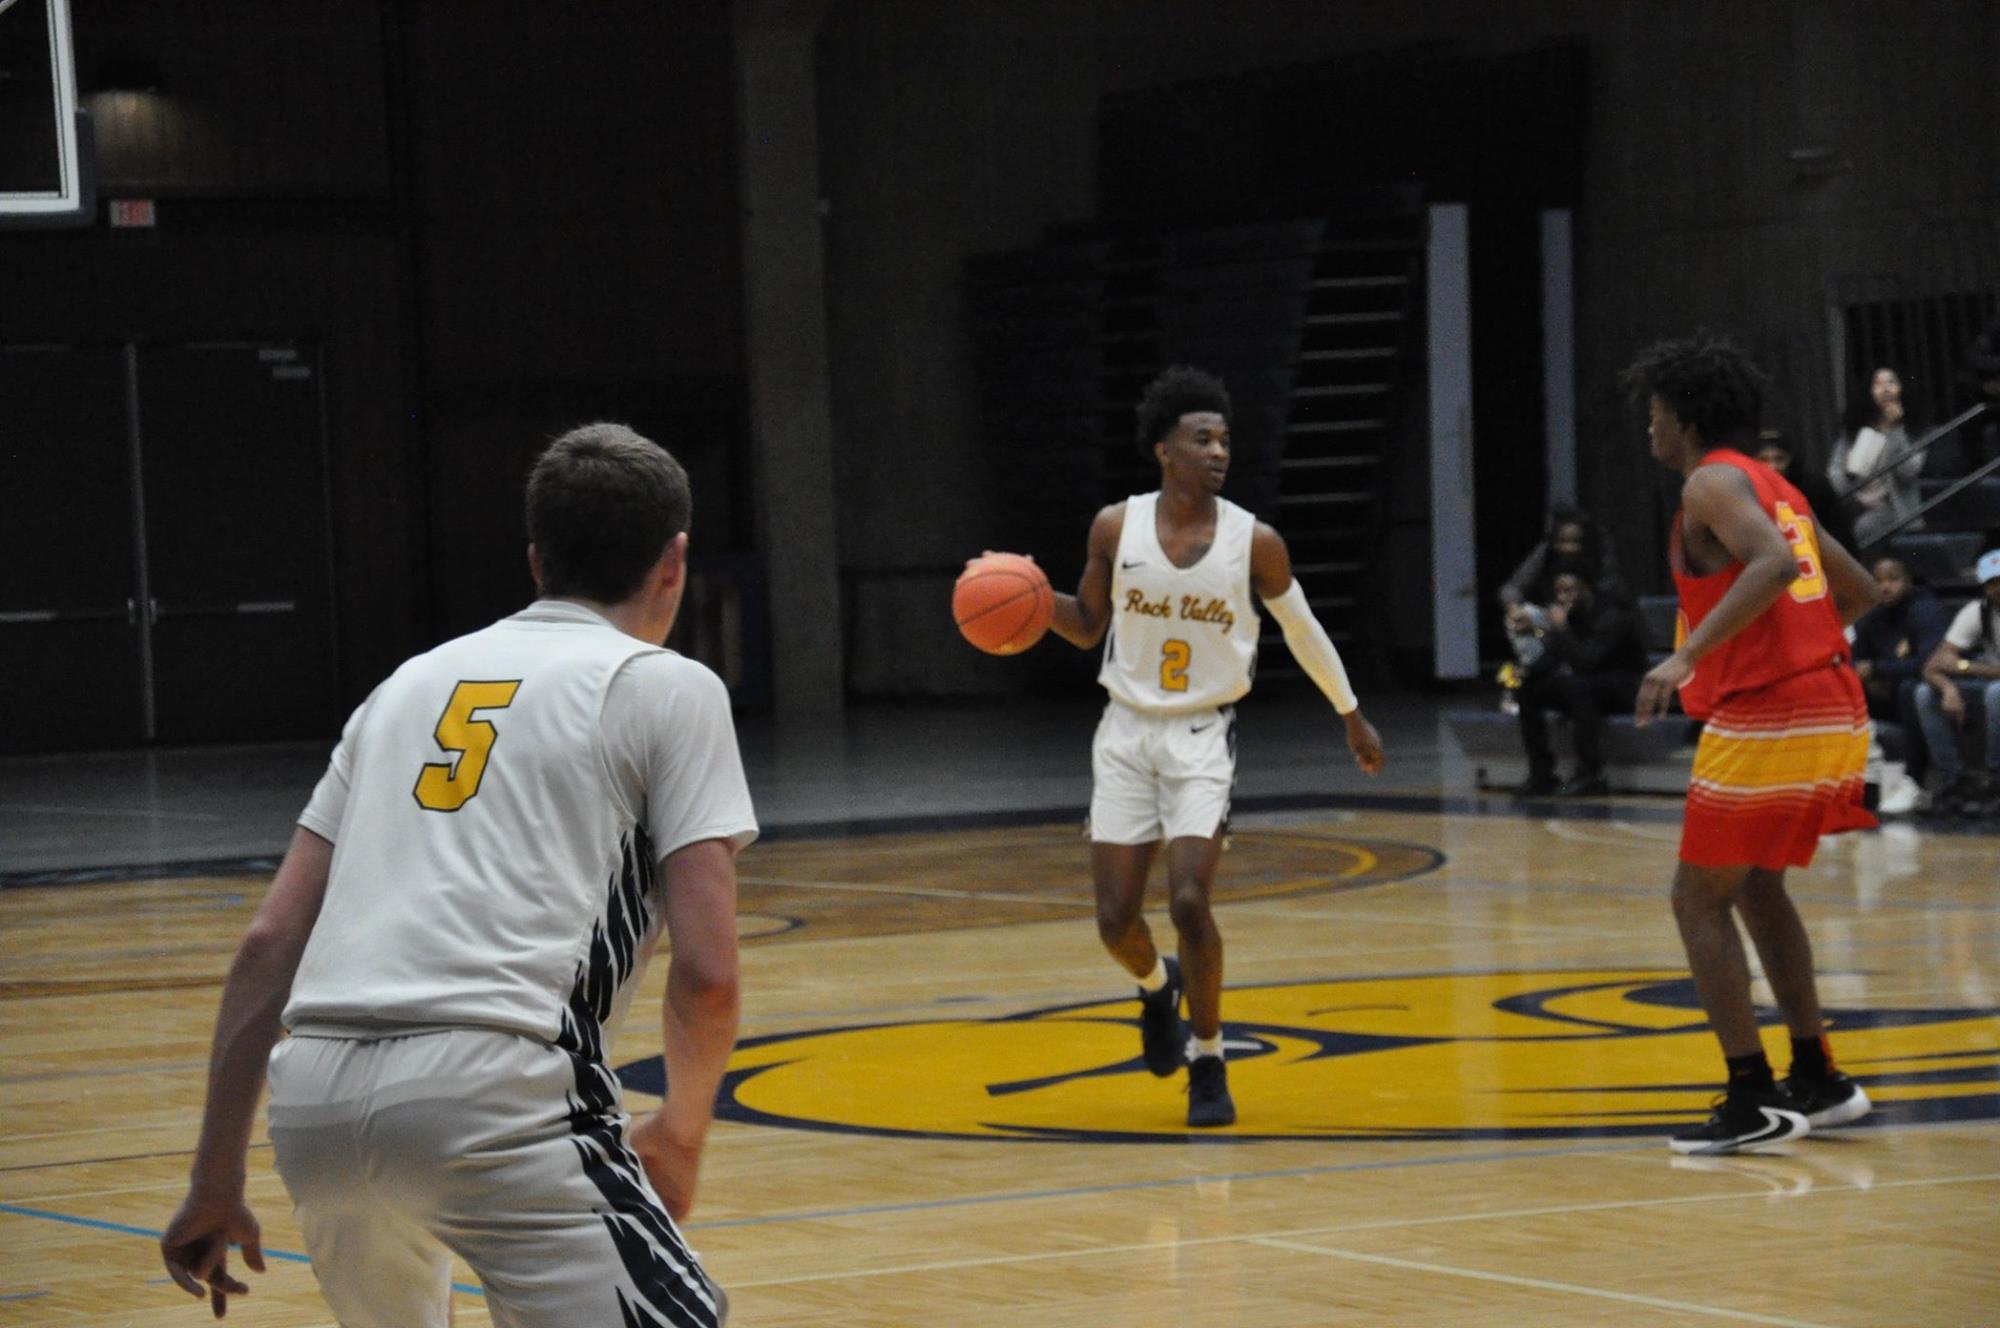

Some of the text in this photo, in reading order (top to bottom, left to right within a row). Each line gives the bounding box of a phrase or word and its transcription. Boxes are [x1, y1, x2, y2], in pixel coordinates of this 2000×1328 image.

[1775, 501, 1828, 603] 3
[1124, 588, 1235, 634] Rock Valley
[1160, 638, 1191, 692] 2
[412, 679, 524, 813] 5
